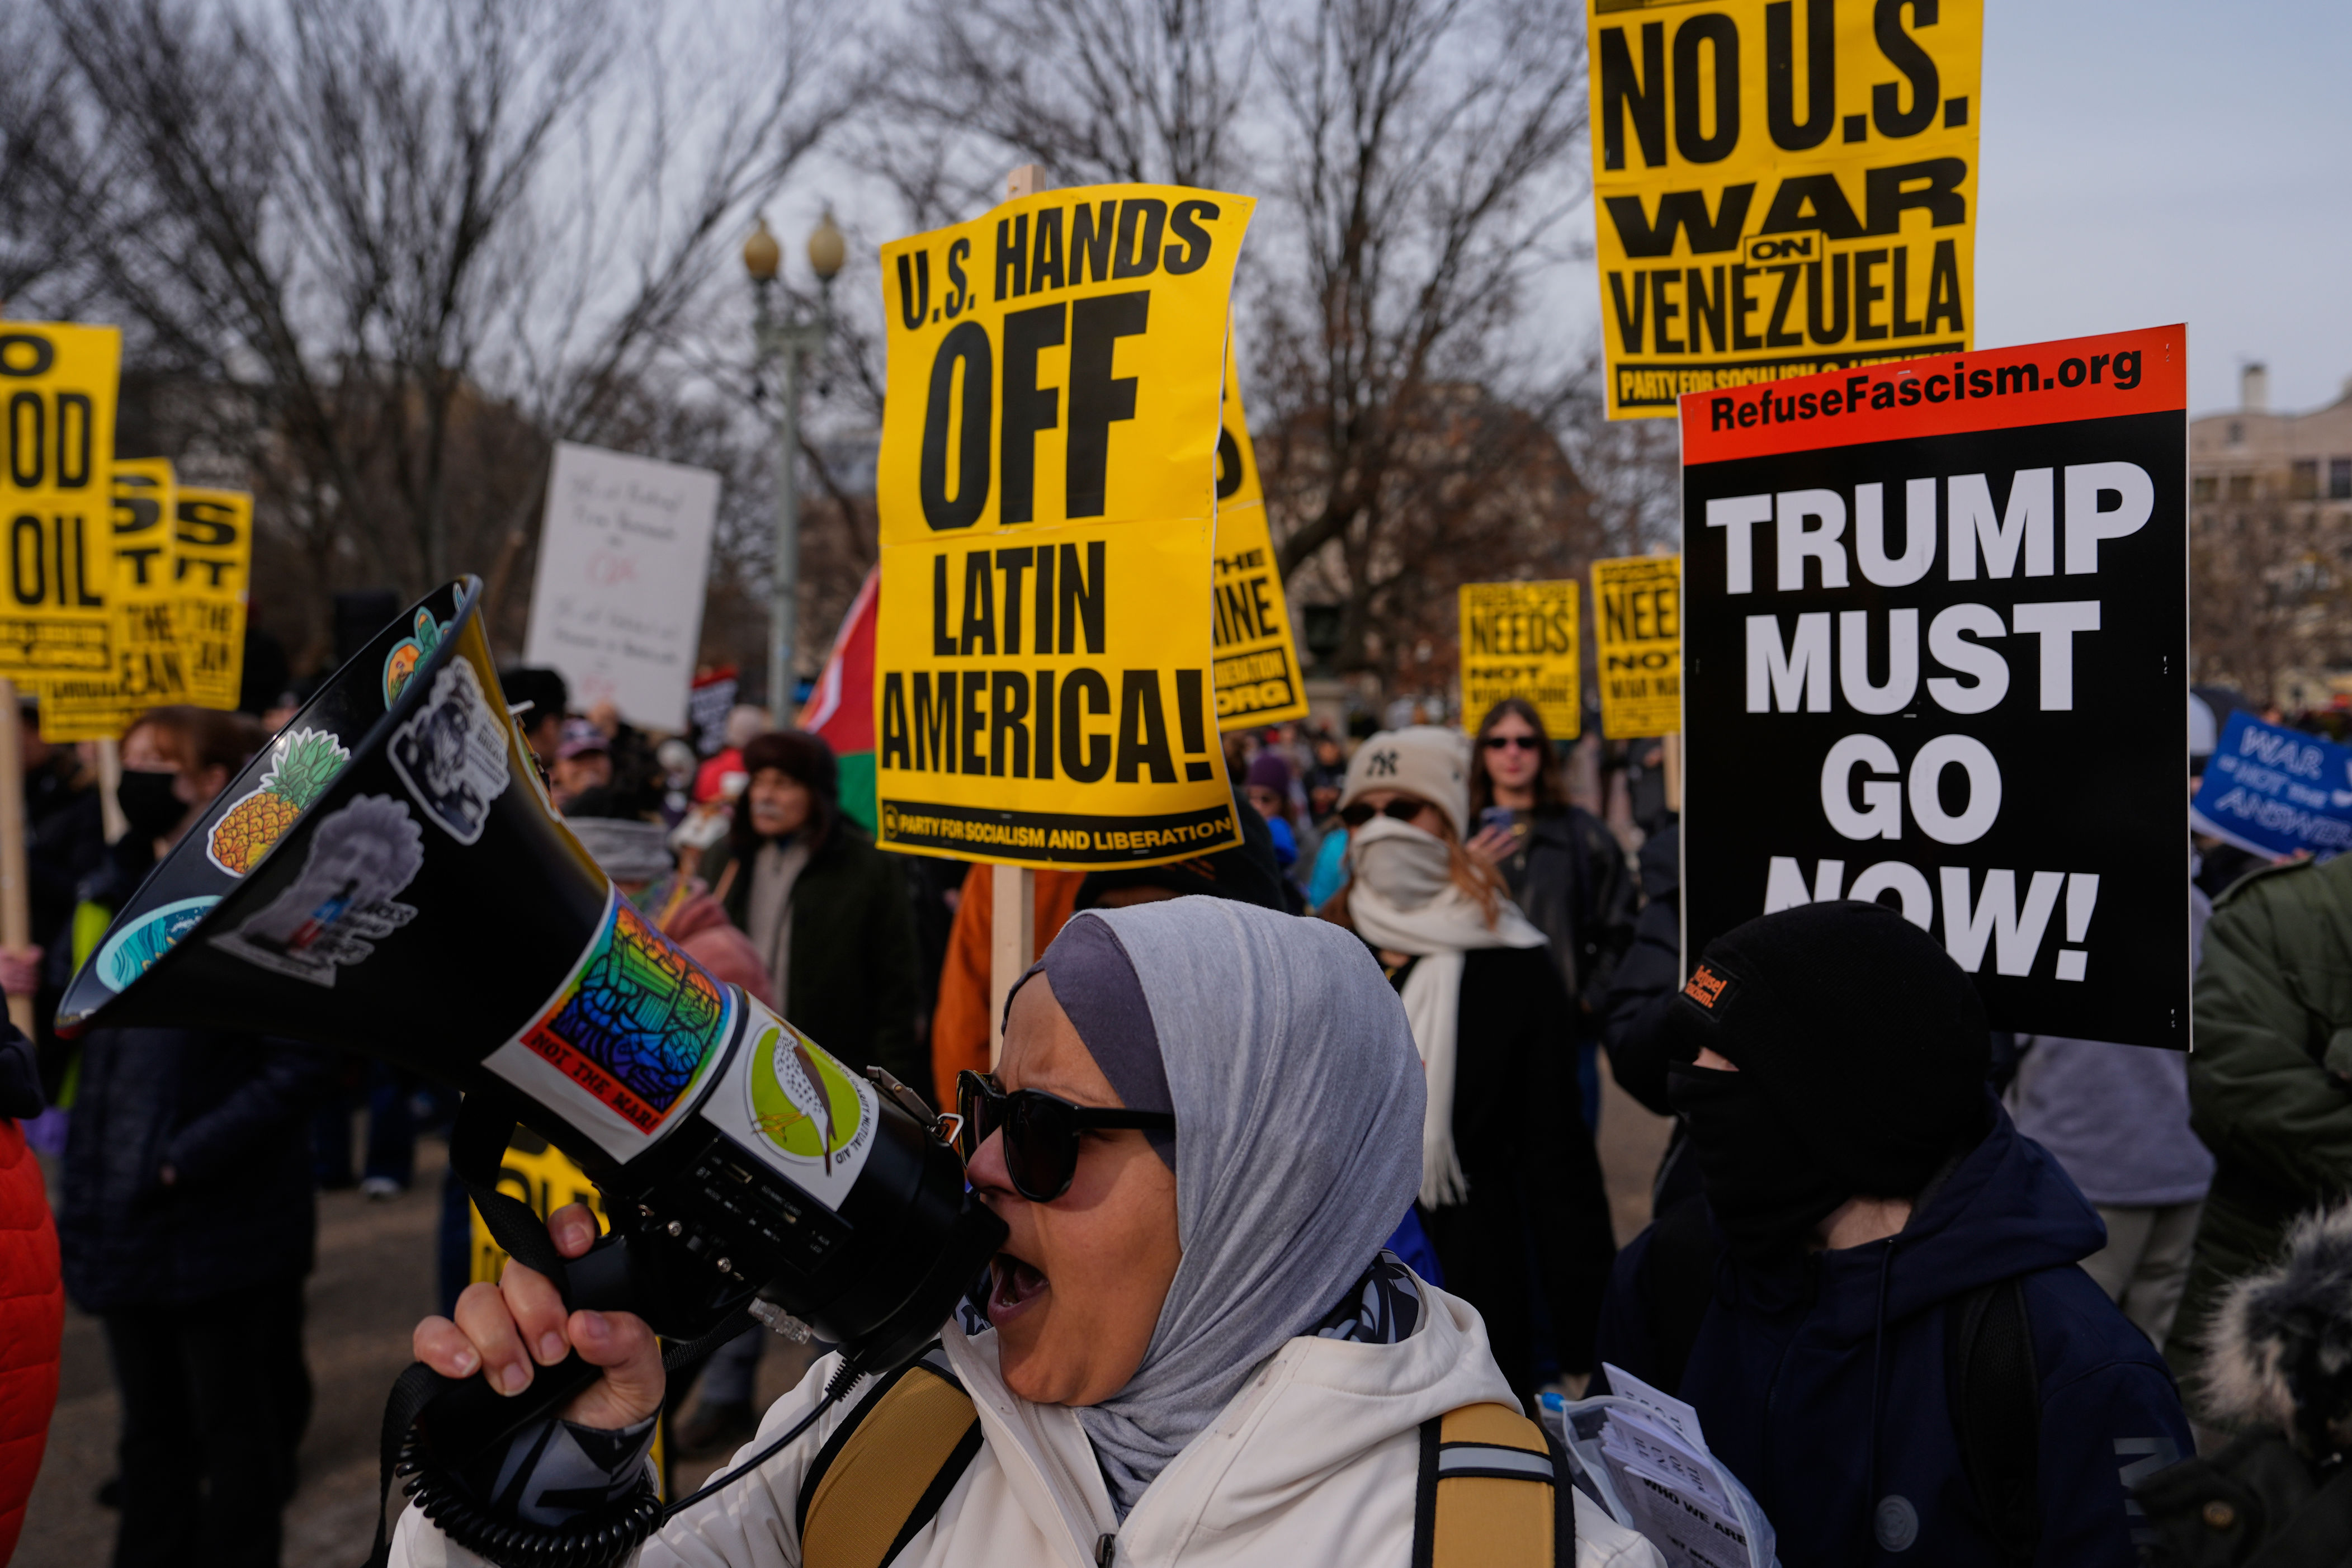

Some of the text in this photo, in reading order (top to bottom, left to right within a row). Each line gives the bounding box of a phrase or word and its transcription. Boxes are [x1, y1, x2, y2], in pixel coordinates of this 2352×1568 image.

[1599, 0, 1969, 171] NO U.S.
[1603, 157, 1968, 259] WAR
[1751, 237, 1812, 261] ON
[897, 198, 1220, 330] U.S. HANDS
[1607, 239, 1964, 355] VENEZUELA
[920, 290, 1150, 531] OFF
[1620, 370, 1678, 401] PARTY
[1711, 350, 2142, 432] RefuseFascism.org
[12, 515, 103, 607] OIL
[1706, 461, 2154, 594] TRUMP
[933, 540, 1106, 656] LATIN
[1214, 576, 1280, 646] INE
[1471, 610, 1570, 655] NEEDS
[1607, 650, 1680, 671] NO
[1746, 599, 2101, 714] MUST
[882, 668, 1213, 783] AMERICA!
[2238, 725, 2324, 781] WAR
[1821, 733, 2002, 845] GO
[899, 816, 939, 836] PARTY
[940, 819, 964, 839] FOR
[965, 821, 1045, 848] SOCIALISM
[1047, 829, 1090, 851] AND
[1092, 816, 1232, 851] LIBERATION
[531, 1032, 572, 1066] NOT
[573, 1060, 611, 1094] THE
[835, 1150, 852, 1165] AID
[849, 1117, 871, 1151] MUTUAL
[1683, 1501, 1710, 1524] WE
[1713, 1521, 1748, 1547] ARE
